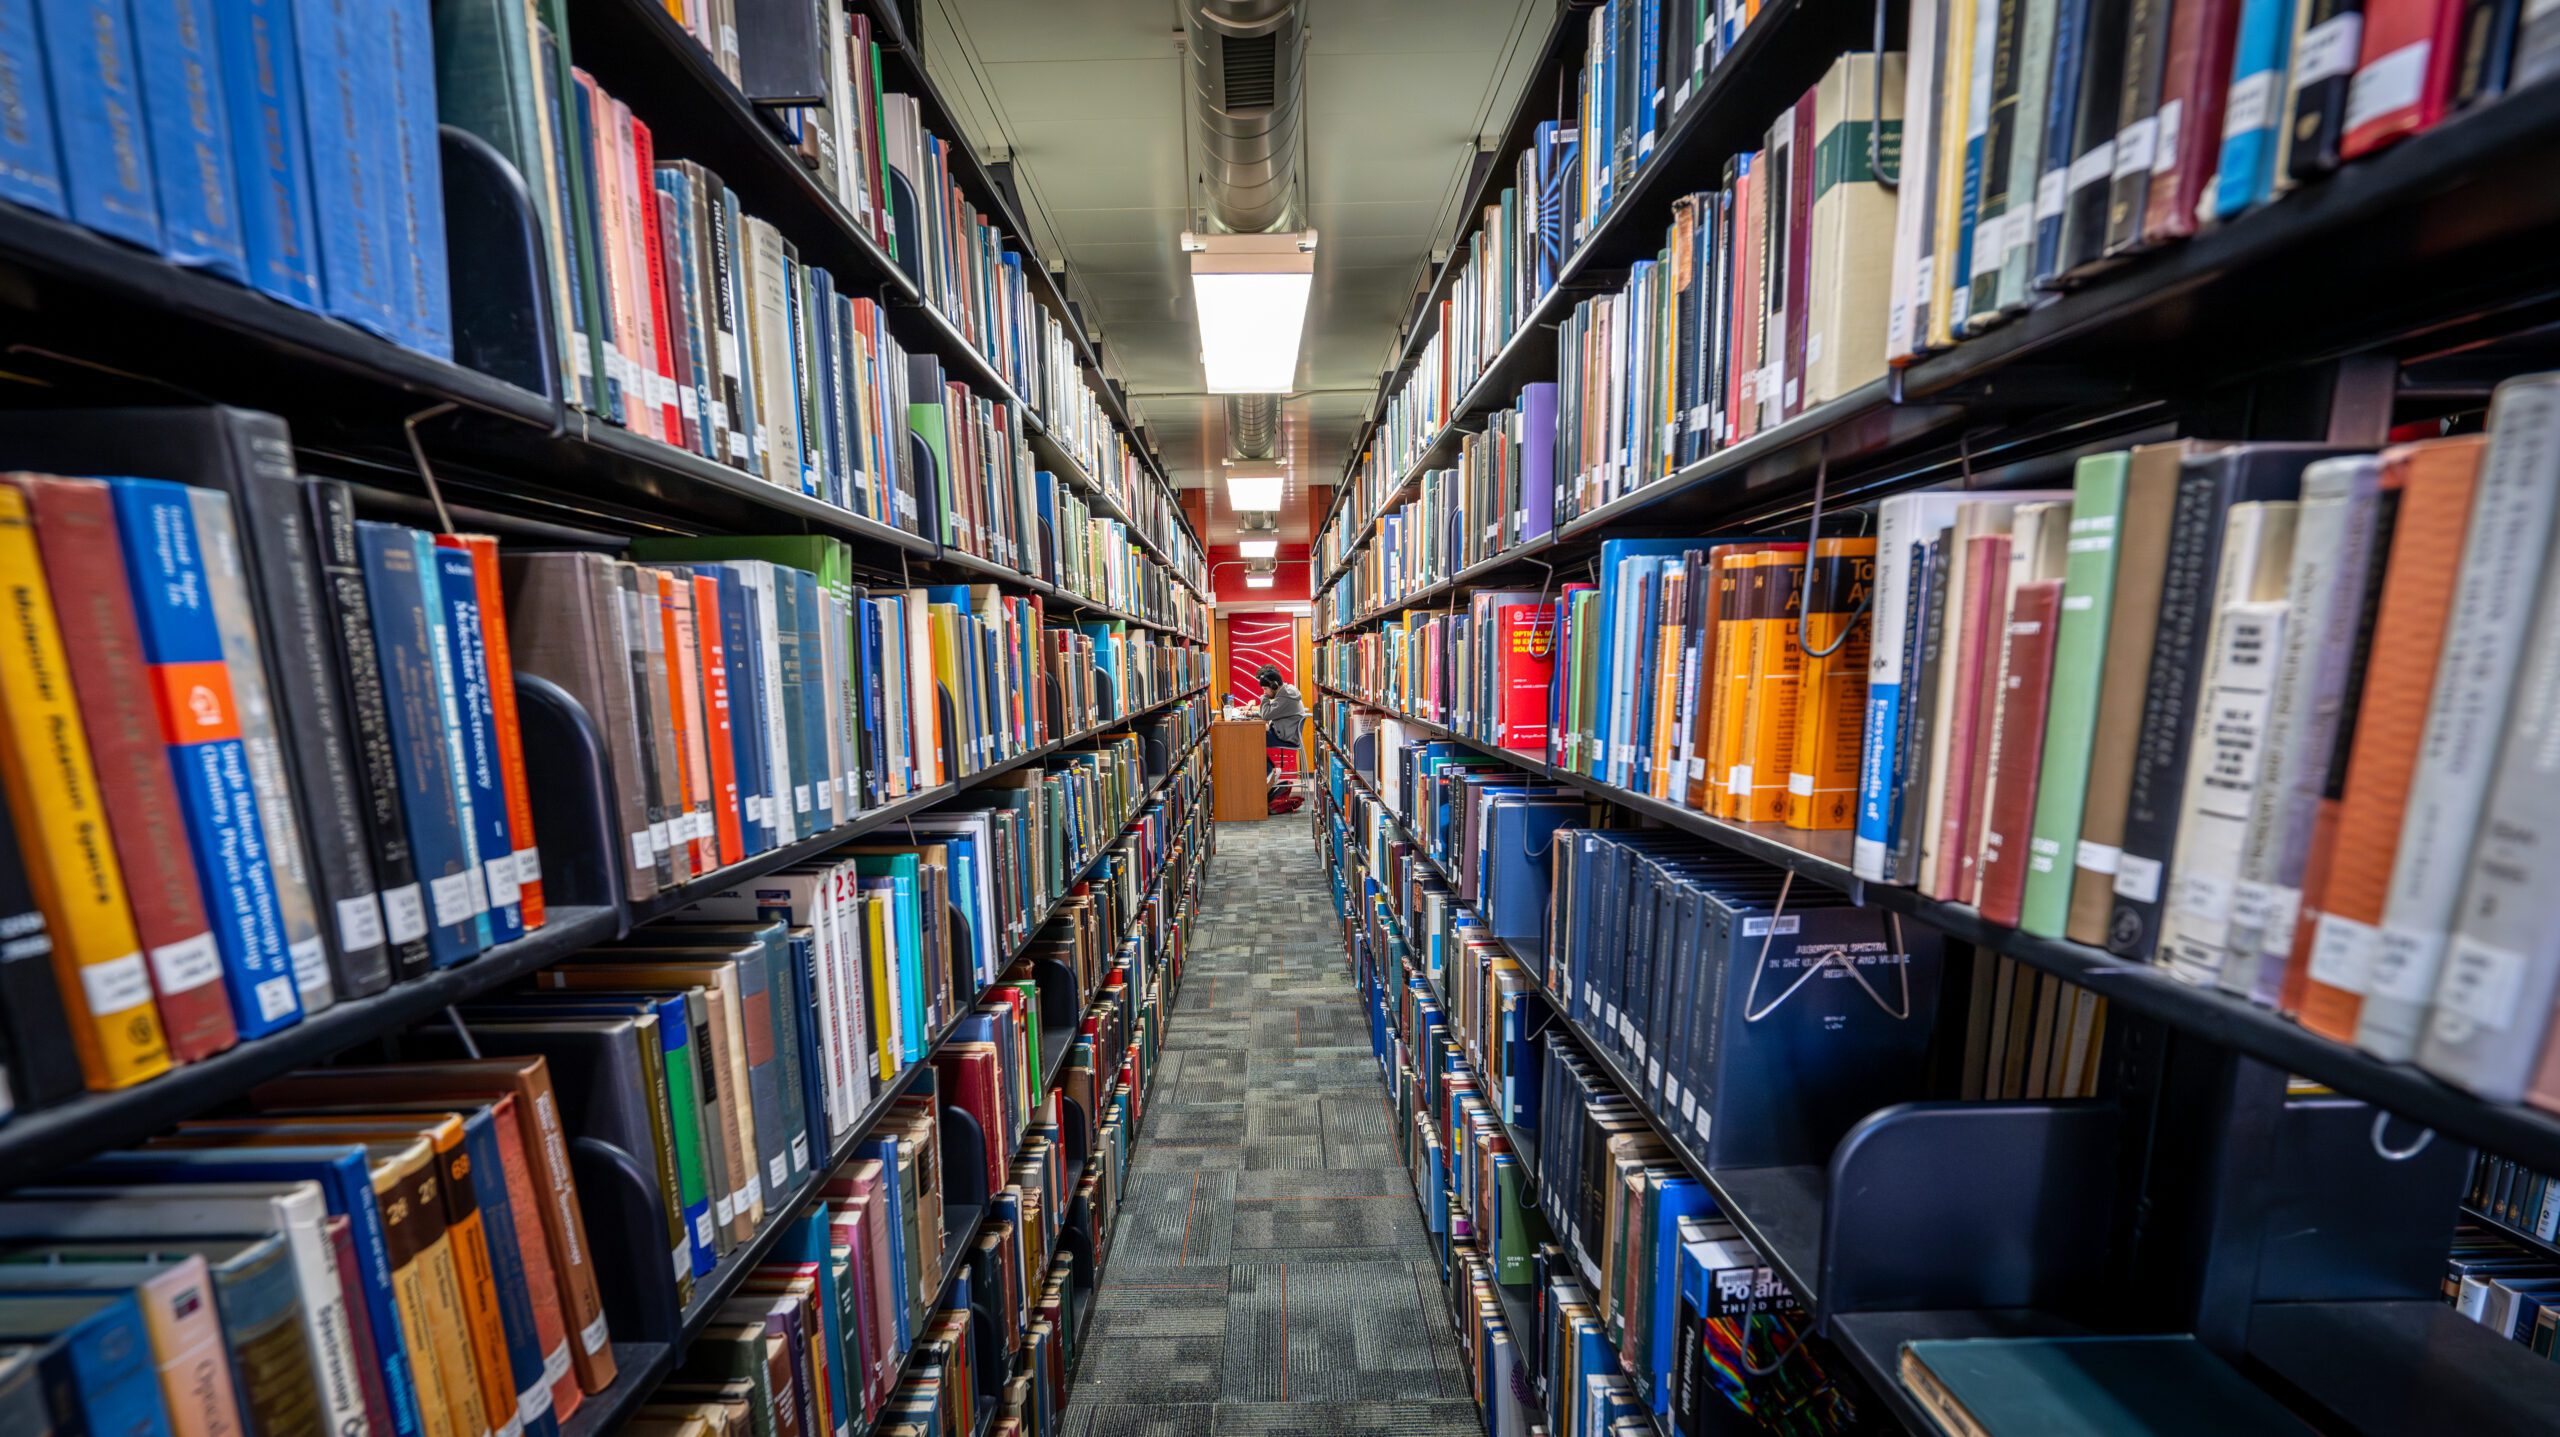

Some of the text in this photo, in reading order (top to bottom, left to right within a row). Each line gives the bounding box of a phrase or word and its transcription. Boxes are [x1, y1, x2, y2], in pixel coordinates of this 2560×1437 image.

[712, 199, 728, 273] radiation
[720, 277, 733, 328] effects
[831, 353, 846, 479] STRANGE GLOW
[1678, 624, 1686, 660] Multiple
[1924, 554, 1948, 661] ZAPPED
[433, 623, 454, 694] Structure
[445, 696, 459, 727] and
[452, 599, 492, 789] Molecular Spectroscopy
[1675, 662, 1684, 704] Scattering
[1866, 699, 1887, 821] Encyclopedia of
[198, 744, 264, 971] Chemistry, Physics and Biology
[219, 741, 285, 972] Single Molecule Spectroscopy in
[821, 883, 829, 911] 1
[835, 874, 845, 903] 2
[846, 870, 855, 898] 3
[824, 943, 833, 983] ORGANIC
[834, 1057, 842, 1087] DIODES
[852, 959, 862, 1034] DISPLAY DEVICES
[1721, 1278, 1791, 1300] Poari
[1680, 1325, 1696, 1415] Polarized Light
